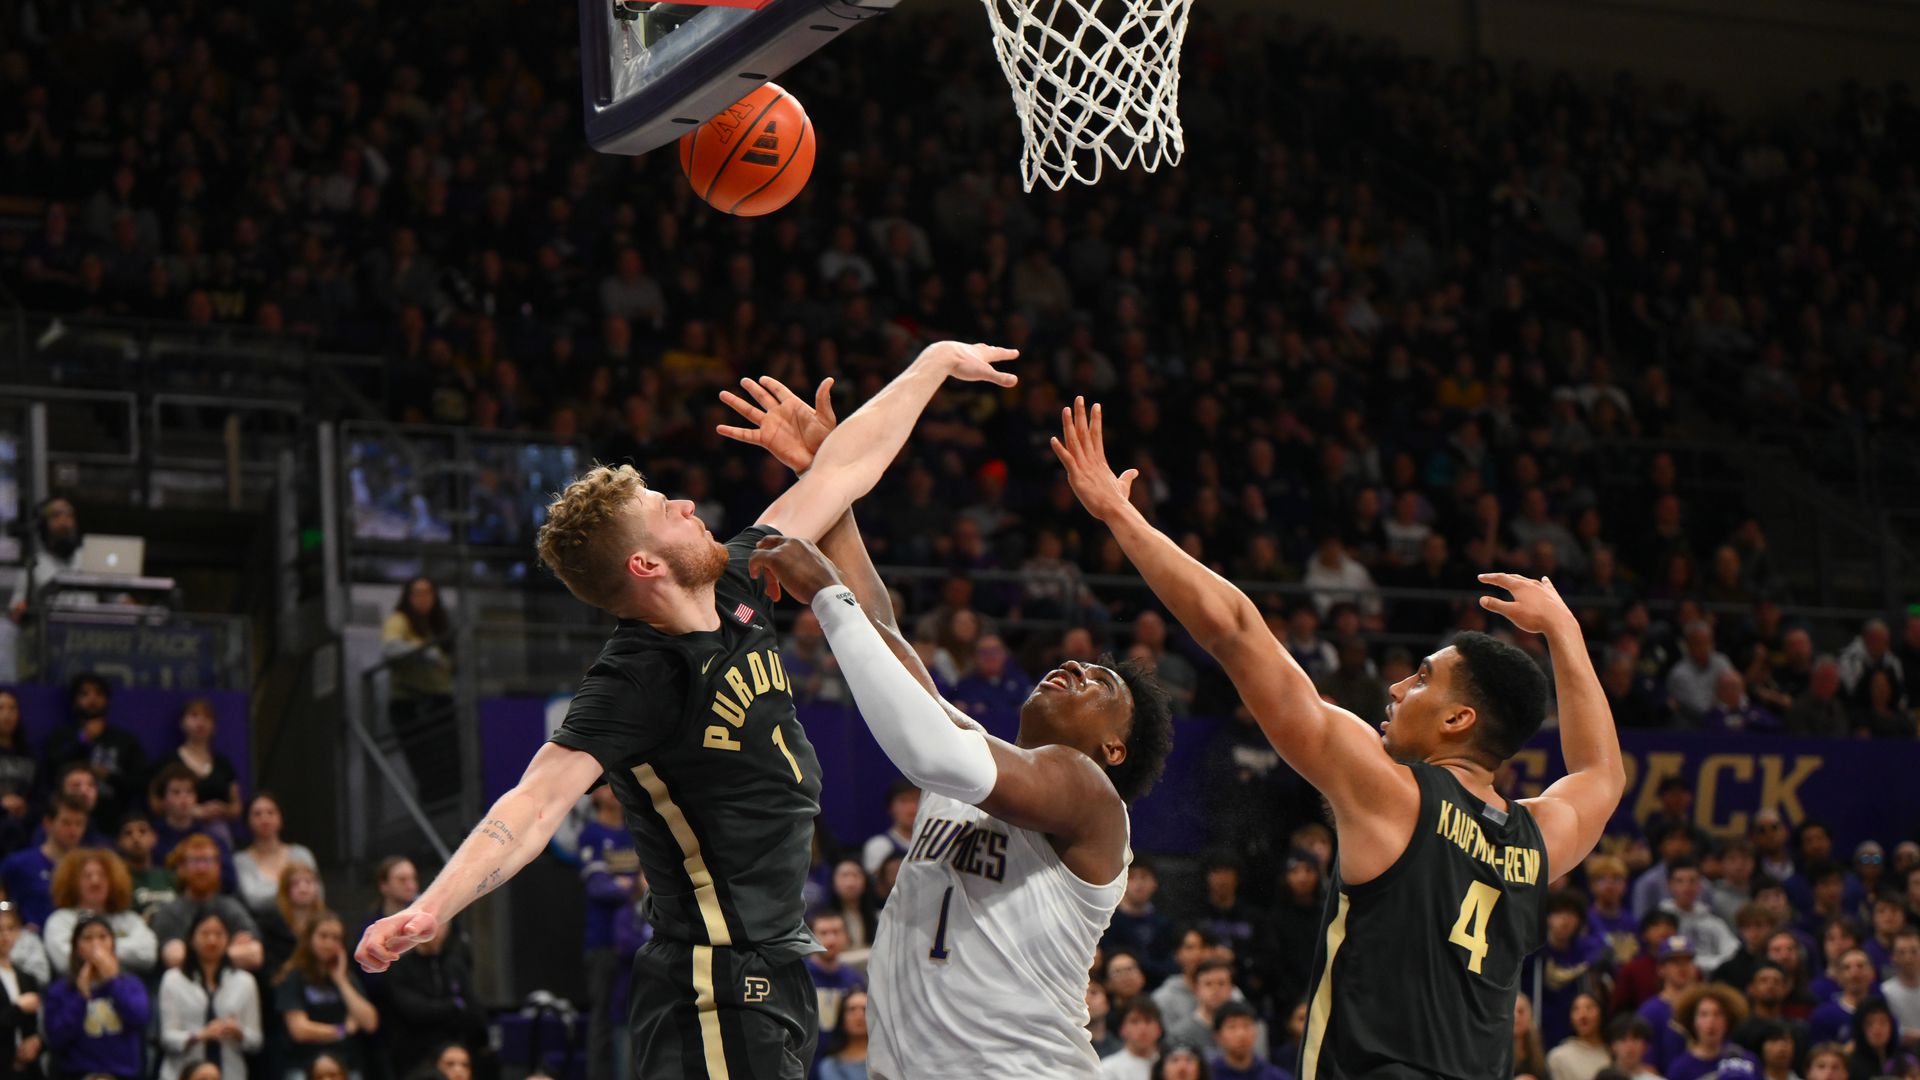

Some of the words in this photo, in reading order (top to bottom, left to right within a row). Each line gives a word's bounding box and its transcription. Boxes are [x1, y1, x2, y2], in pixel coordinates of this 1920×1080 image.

[703, 650, 793, 752] PURDU
[771, 724, 804, 785] 1
[1620, 751, 1824, 841] ACK
[928, 885, 954, 960] 1
[1448, 879, 1502, 976] 4
[743, 976, 771, 1002] P
